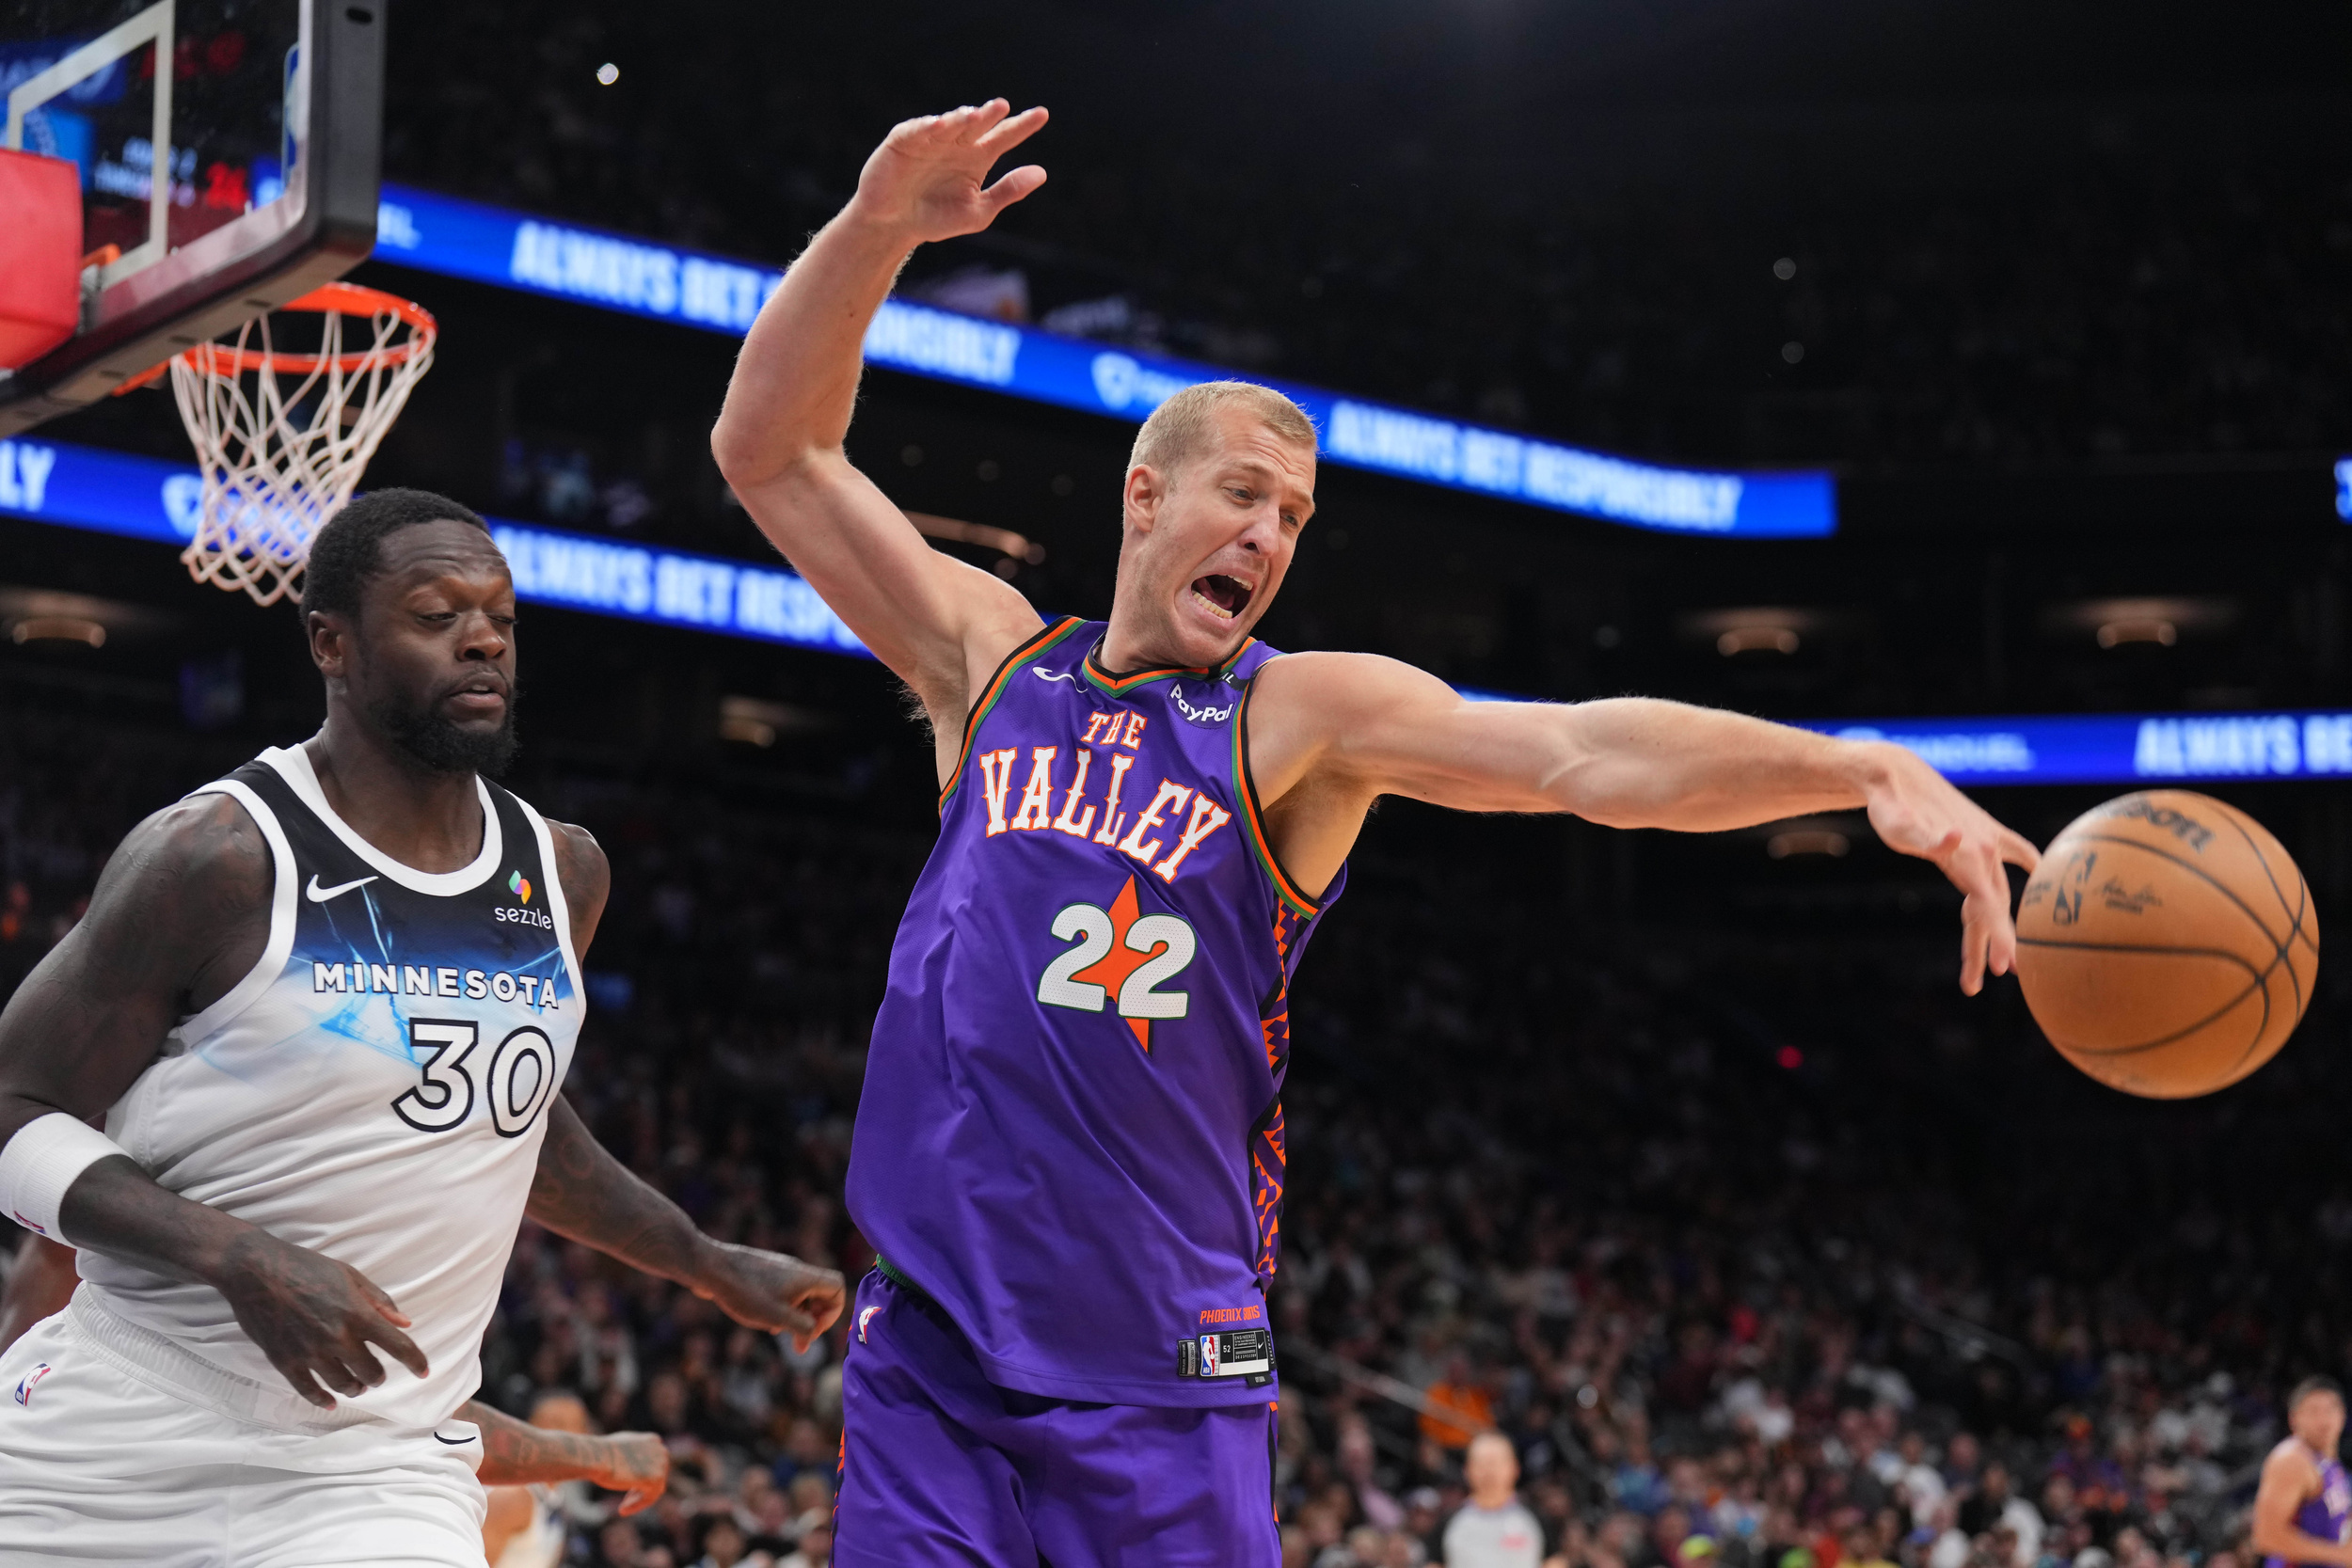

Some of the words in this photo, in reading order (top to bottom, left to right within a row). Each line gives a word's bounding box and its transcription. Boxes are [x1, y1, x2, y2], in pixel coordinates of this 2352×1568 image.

[510, 220, 678, 315] ALWAYS
[680, 257, 762, 331] BET
[1327, 400, 1457, 482] ALWAYS
[1461, 426, 1521, 495] BET
[1525, 440, 1743, 531] RESPONSIBLY
[493, 525, 653, 614] ALWAYS
[655, 554, 736, 627] BET
[1080, 710, 1148, 749] THE
[1169, 683, 1233, 722] PayPal
[2134, 715, 2299, 777] ALWAYS
[978, 745, 1232, 884] VALLEY
[494, 906, 553, 930] sezzle
[312, 961, 559, 1009] MINNESOTA
[1036, 901, 1199, 1020] 22
[390, 1017, 556, 1139] 30
[1200, 1307, 1242, 1324] PHOENIX
[1222, 1344, 1232, 1354] 52
